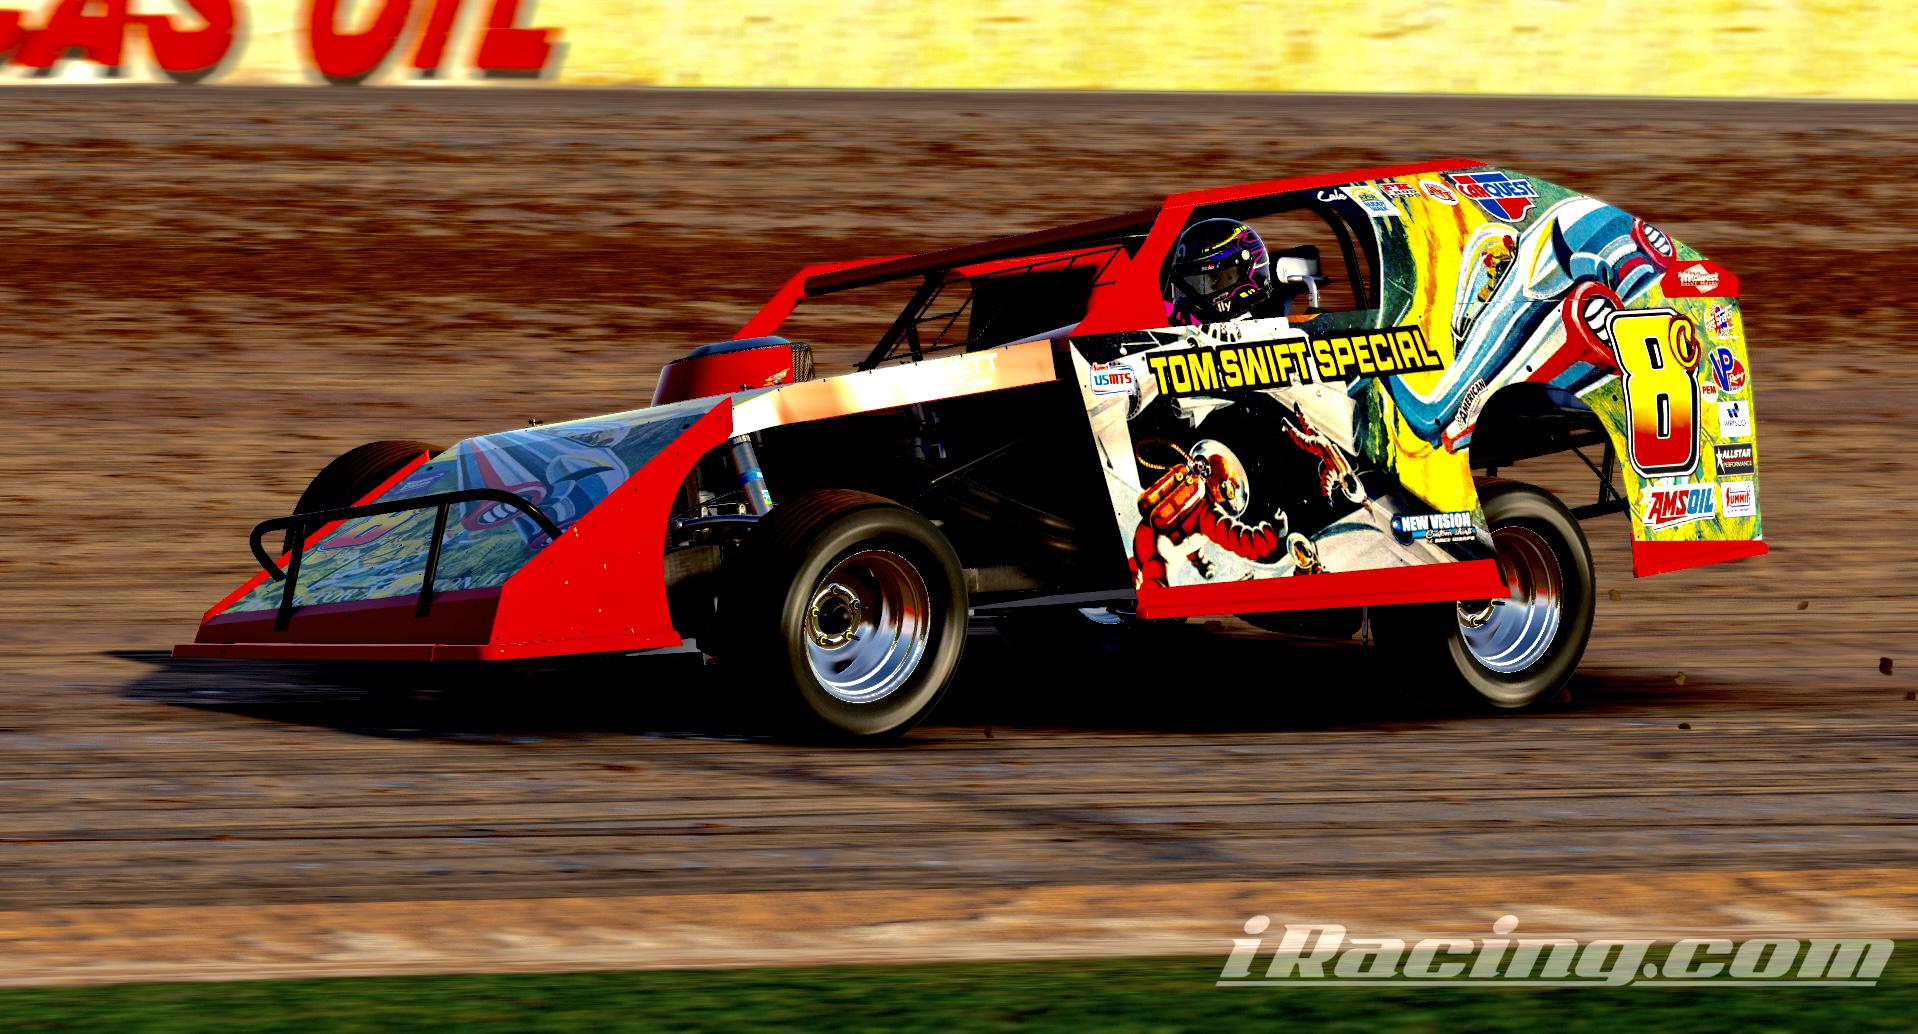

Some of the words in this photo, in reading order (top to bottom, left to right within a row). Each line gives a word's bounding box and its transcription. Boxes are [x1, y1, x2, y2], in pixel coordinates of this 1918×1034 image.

[0, 0, 235, 71] AS
[1458, 181, 1536, 199] CARQUEST
[1150, 352, 1220, 395] TOM
[1218, 341, 1310, 388] SWIFT
[1312, 329, 1441, 377] SPECIAL
[1708, 346, 1734, 392] VP
[1094, 372, 1133, 386] USMTS
[1702, 385, 1717, 395] PEM
[1459, 379, 1486, 425] AMERICAN
[1722, 448, 1752, 460] ALLSTAR
[1723, 460, 1752, 468] PERFORMANCE
[1648, 488, 1714, 524] AMSOIL
[1402, 515, 1429, 532] NEW
[1430, 512, 1471, 530] VISION
